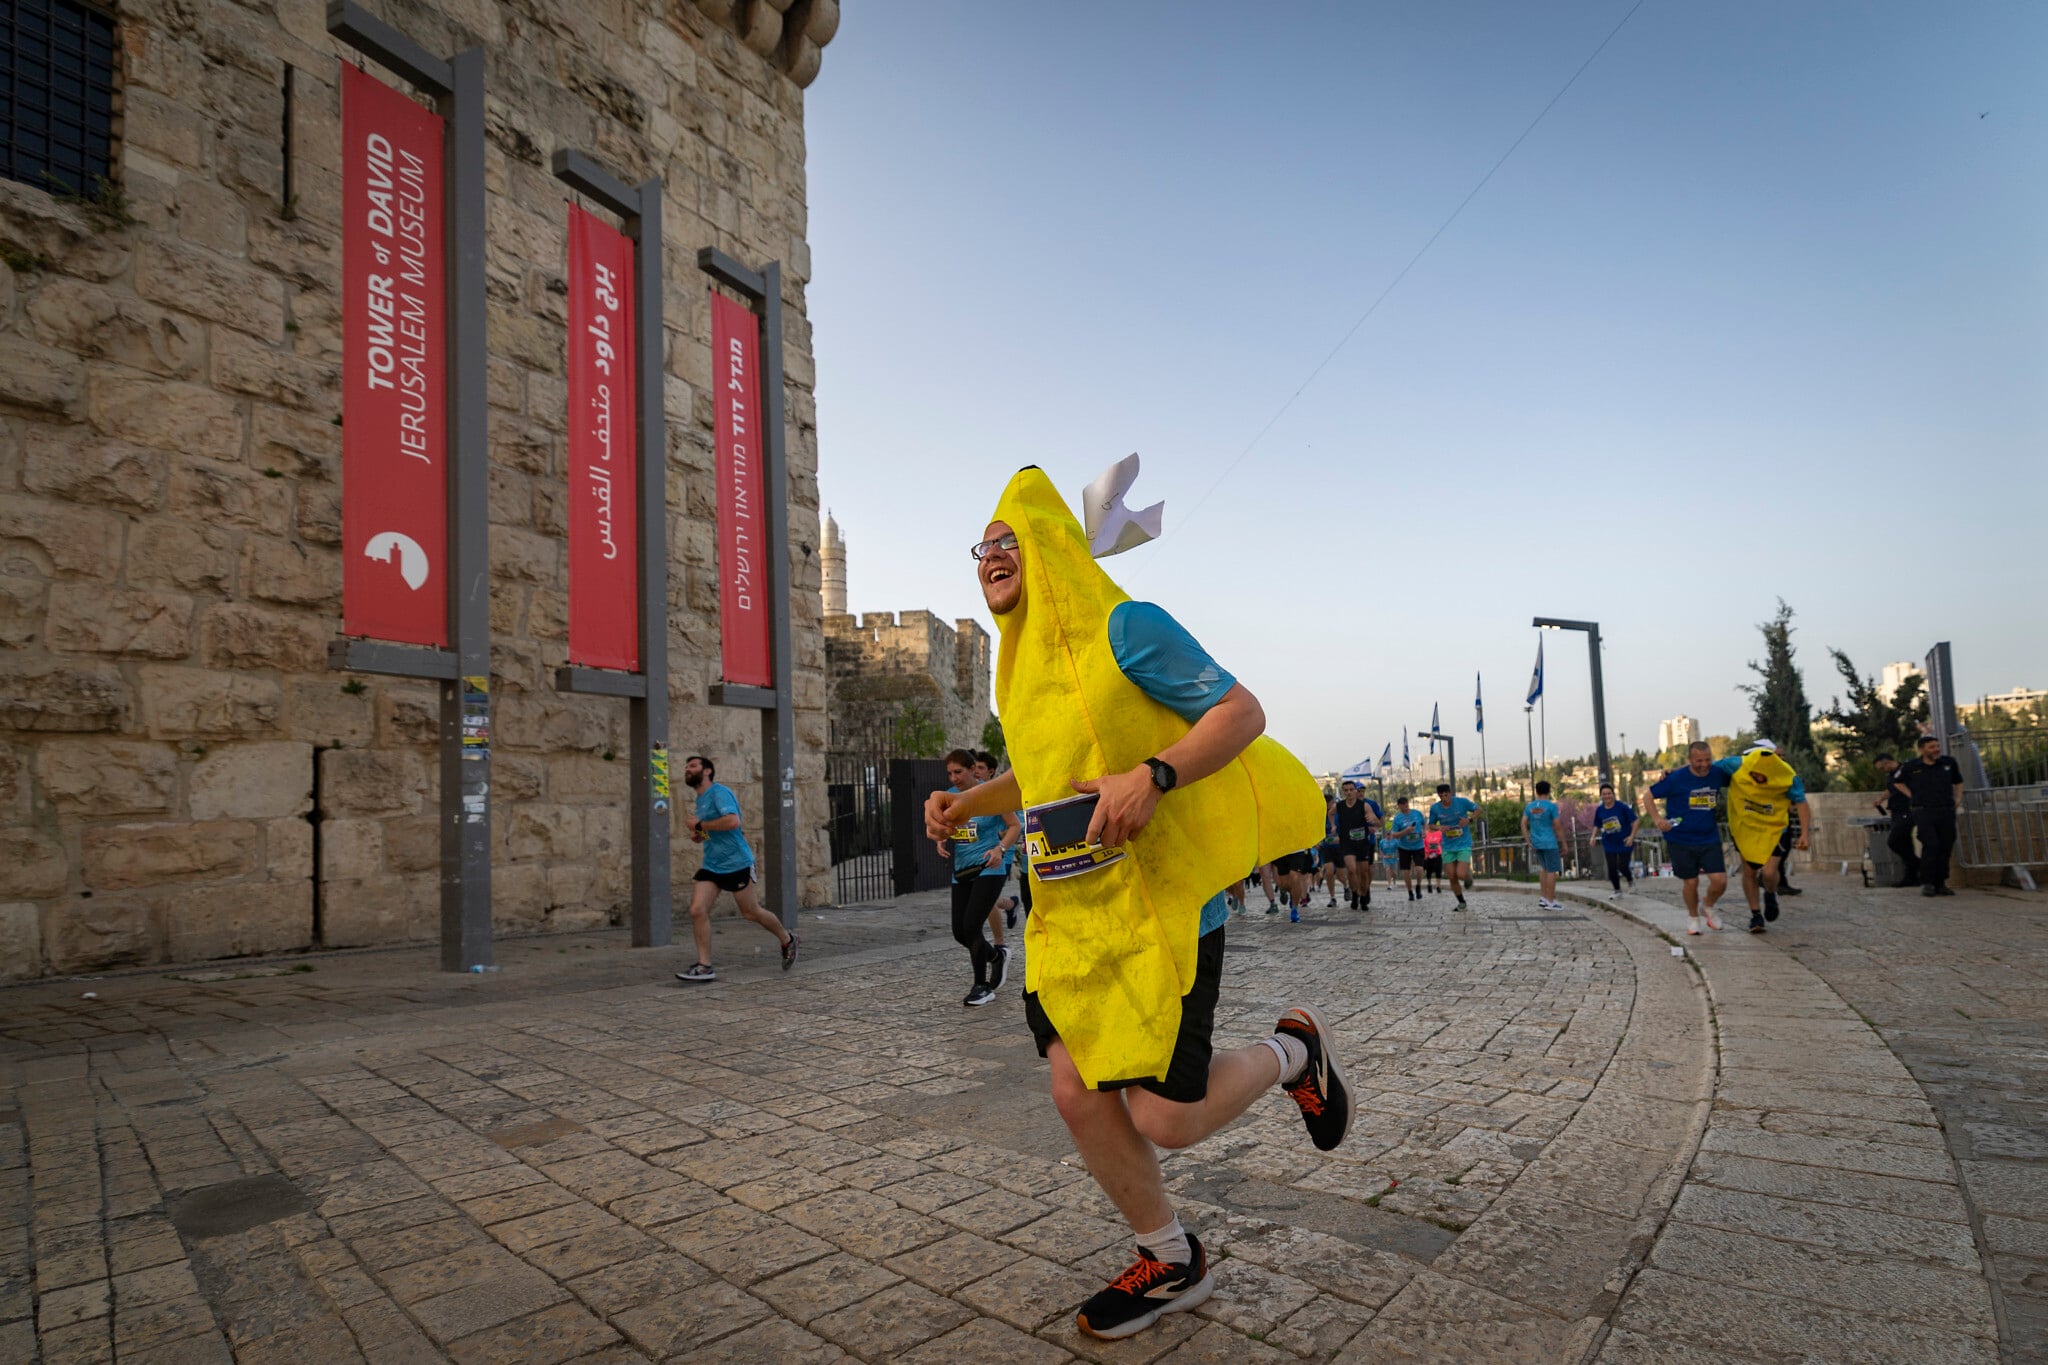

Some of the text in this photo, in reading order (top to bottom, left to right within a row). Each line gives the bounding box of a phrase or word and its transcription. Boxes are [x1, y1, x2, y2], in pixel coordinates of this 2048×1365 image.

[367, 133, 394, 390] TOWER of DAVID
[399, 149, 431, 464] JERUSALEM MUSEUM
[588, 262, 619, 560] برج داود متحف القدس
[729, 337, 751, 610] מגדל דוד מוזיאון ירושלים
[1031, 842, 1039, 855] A
